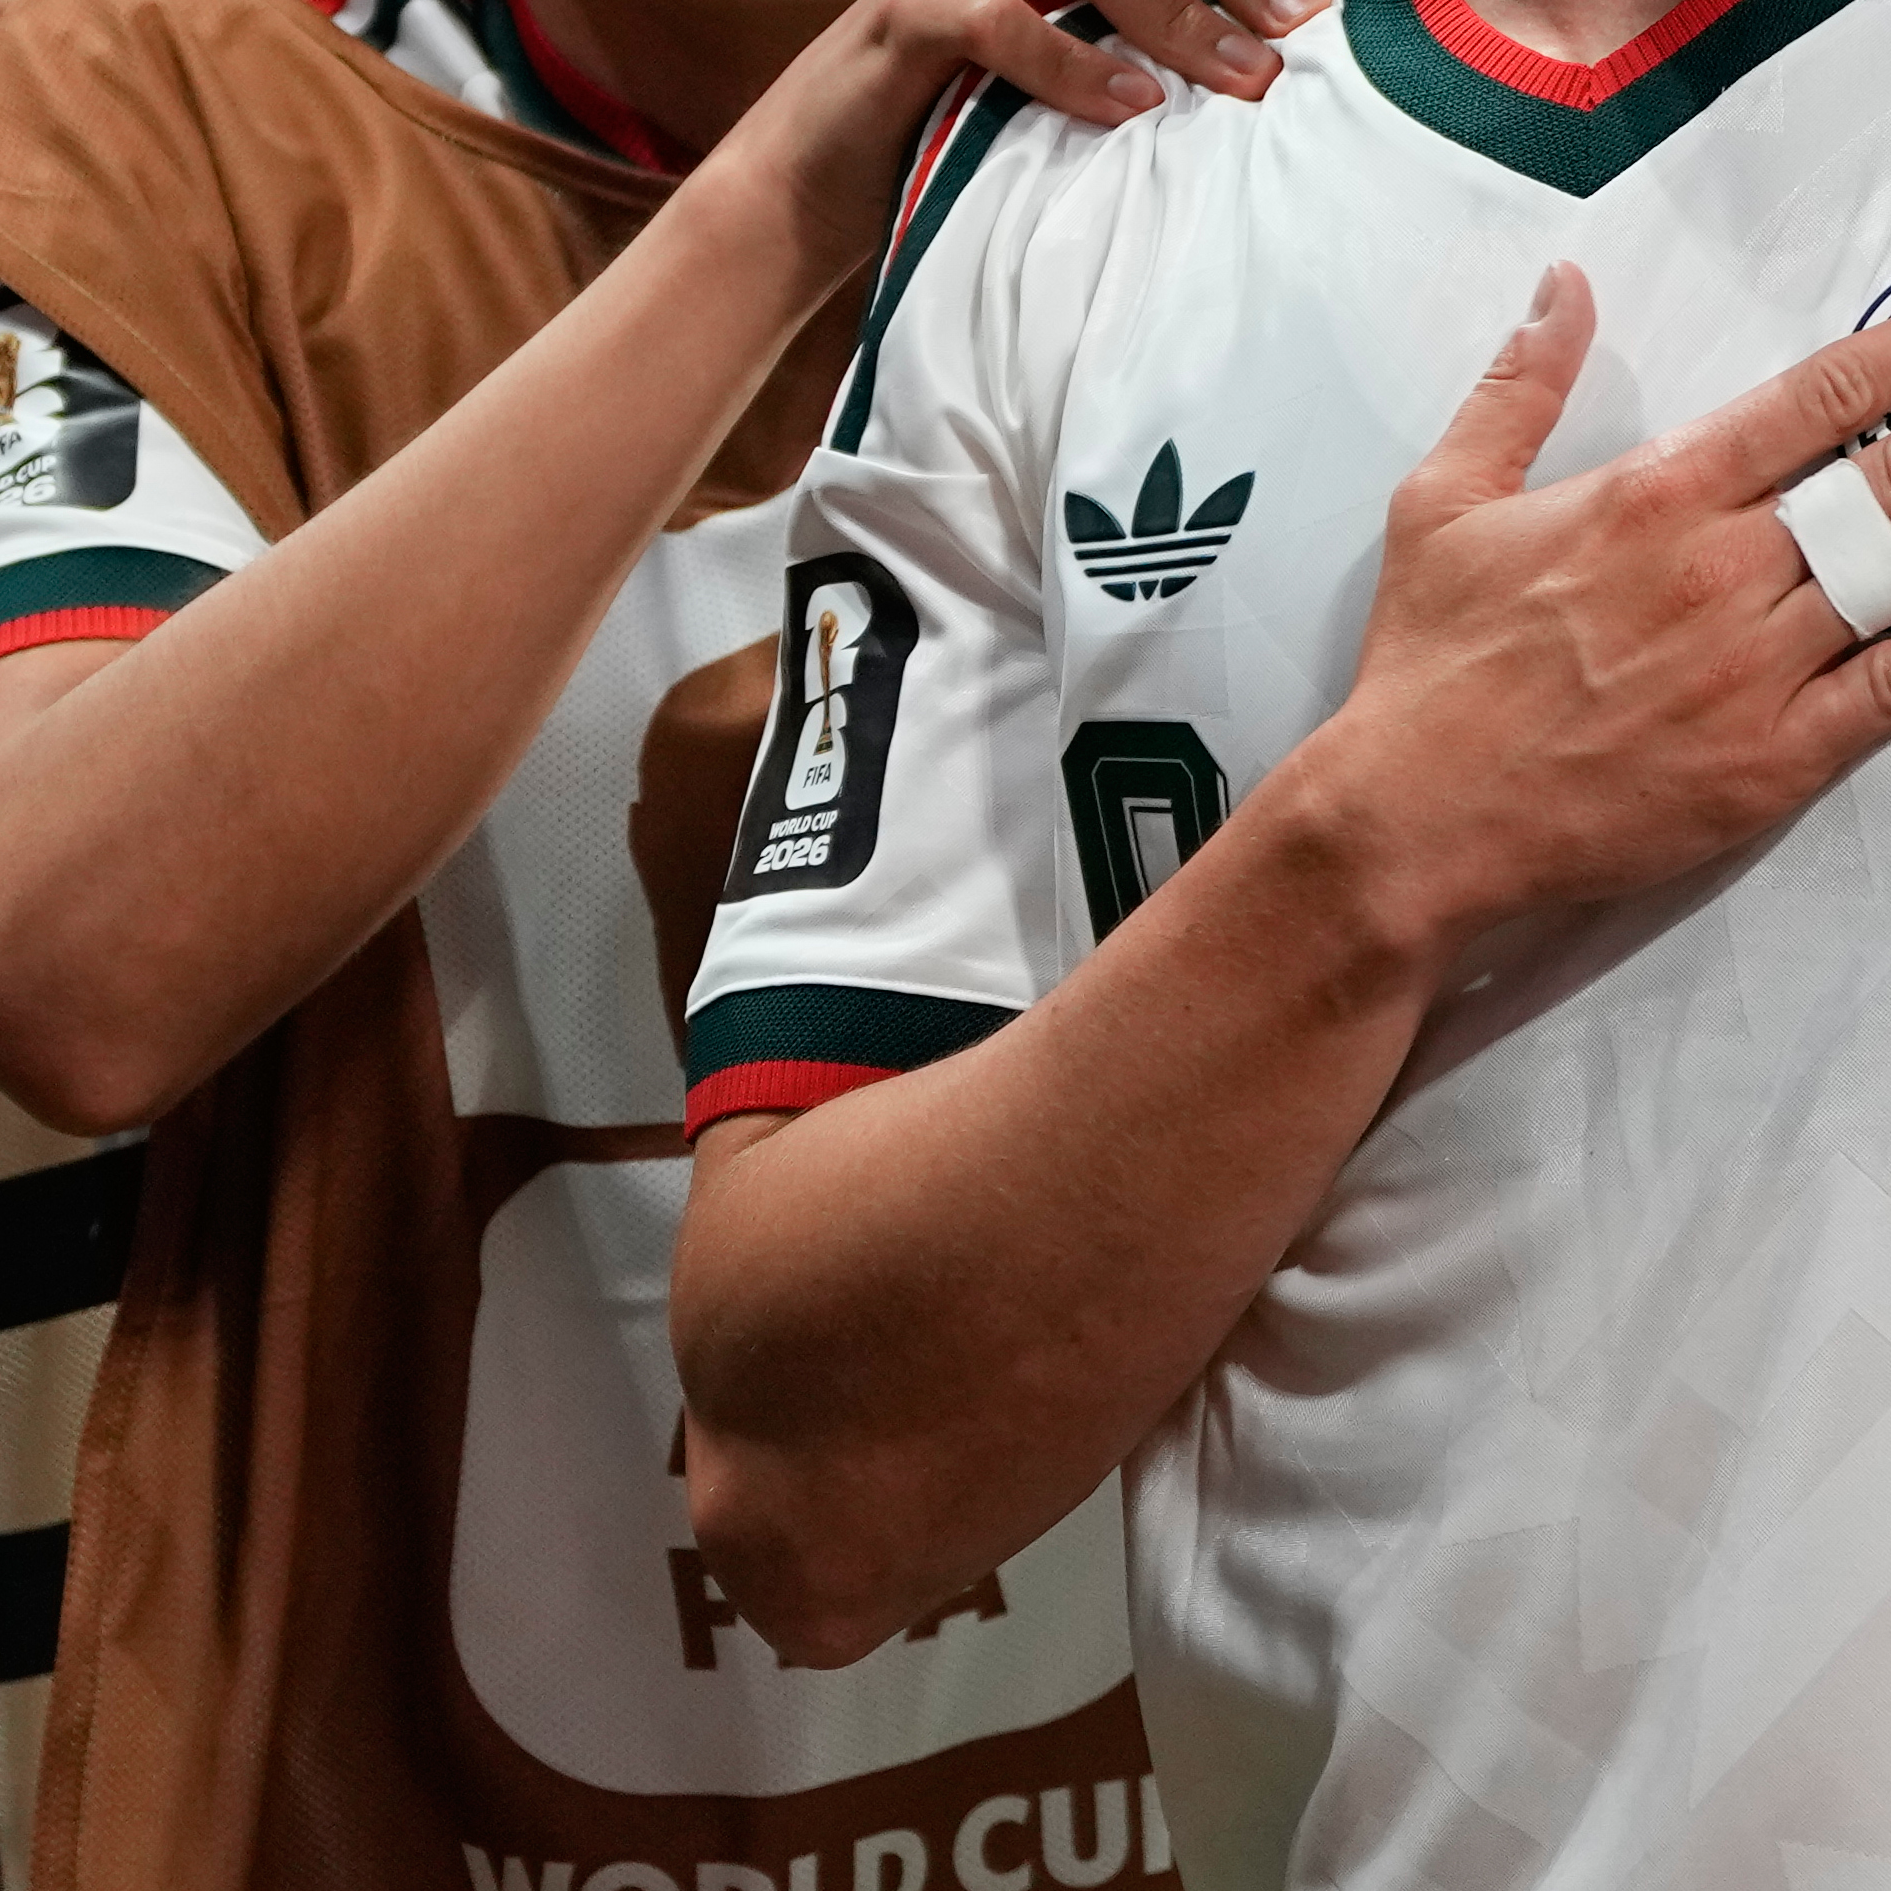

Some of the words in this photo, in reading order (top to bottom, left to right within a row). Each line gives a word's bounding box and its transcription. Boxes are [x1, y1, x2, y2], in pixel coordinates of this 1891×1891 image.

[802, 762, 832, 789] FIFA
[768, 814, 812, 841] WORLD
[811, 809, 838, 832] CUP
[752, 834, 831, 875] 2026
